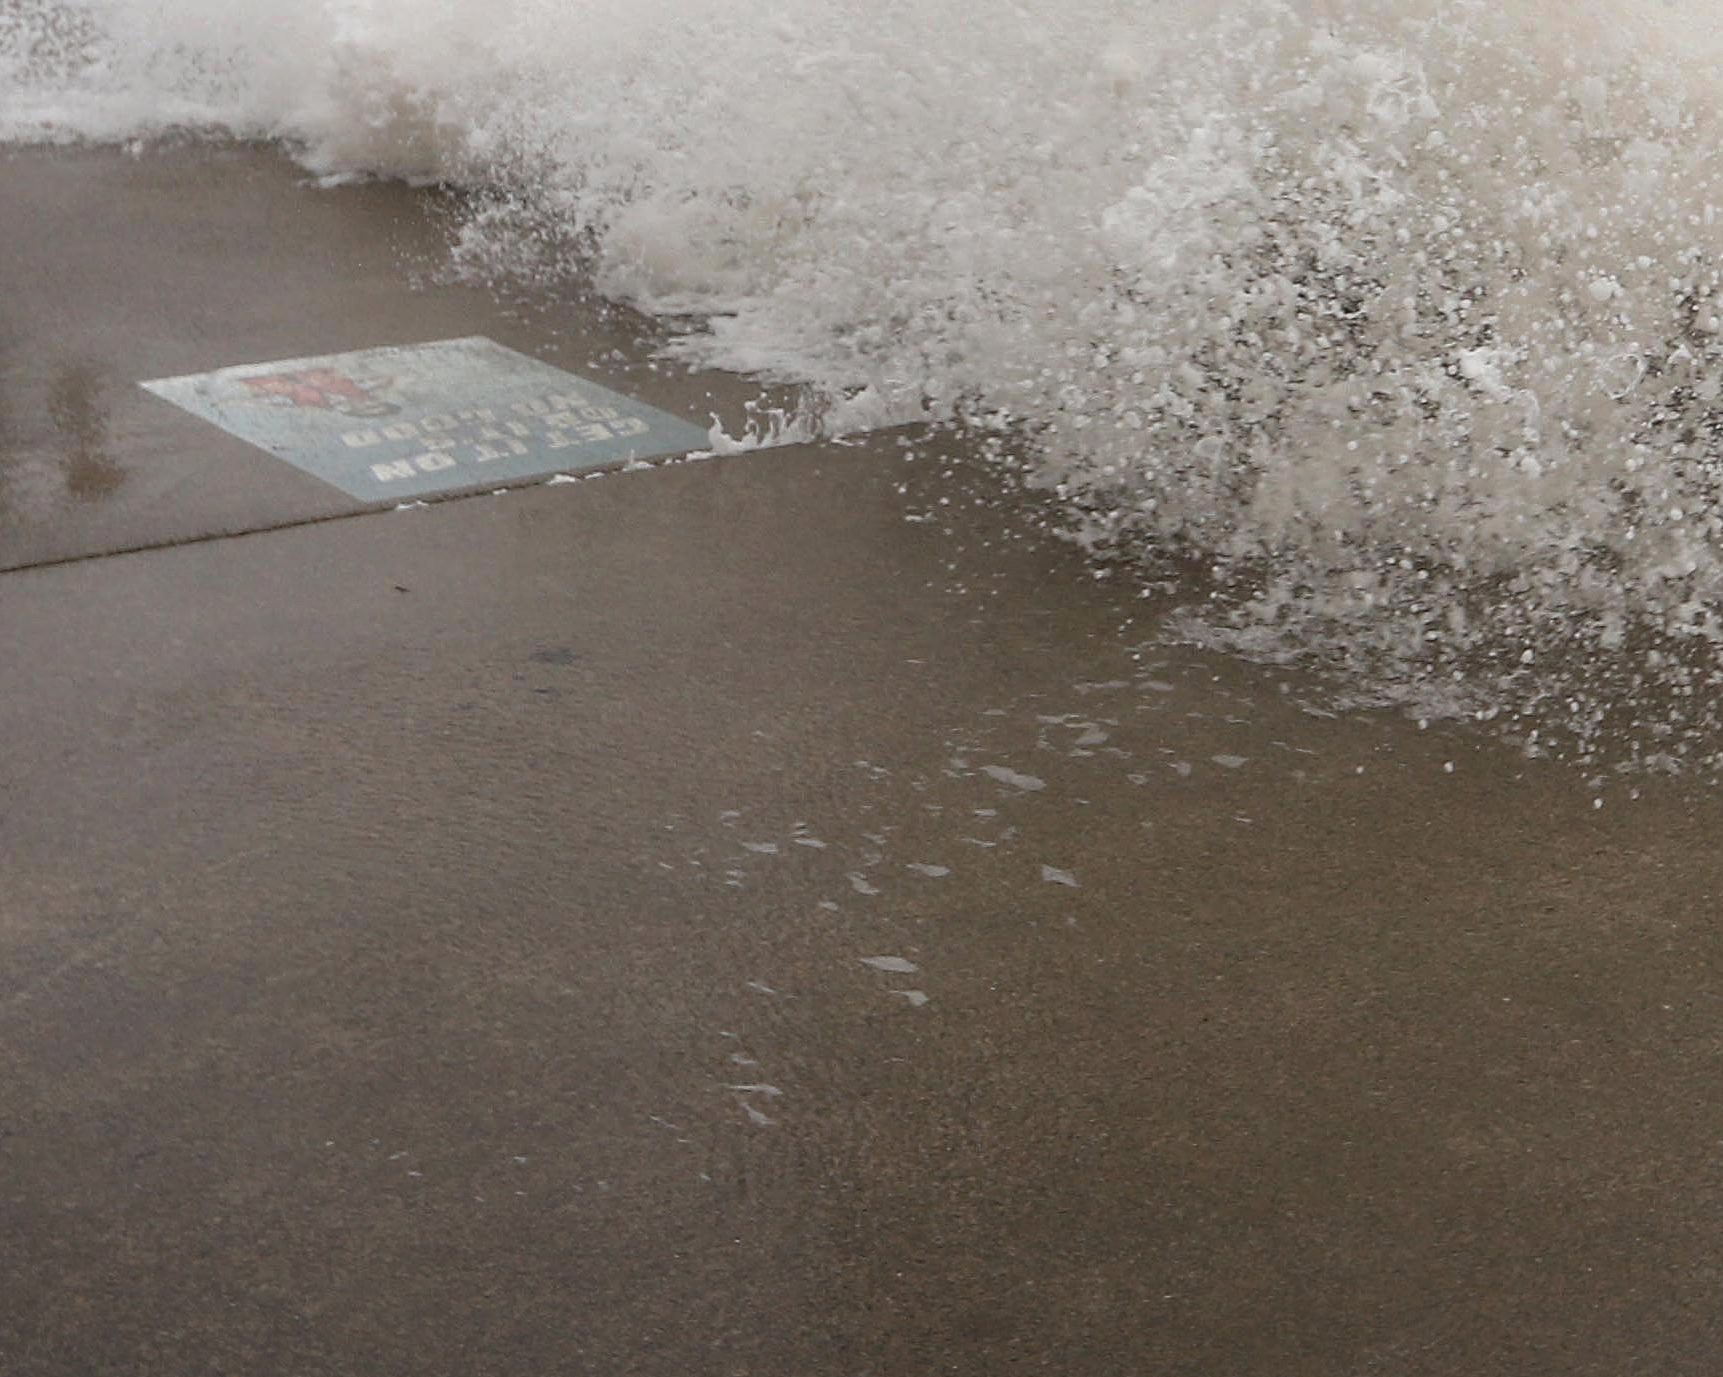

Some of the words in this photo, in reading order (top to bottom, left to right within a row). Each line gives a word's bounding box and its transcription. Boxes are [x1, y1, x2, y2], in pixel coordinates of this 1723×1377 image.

[547, 416, 649, 448] GET
[475, 438, 528, 462] IT
[370, 451, 457, 482] ON
